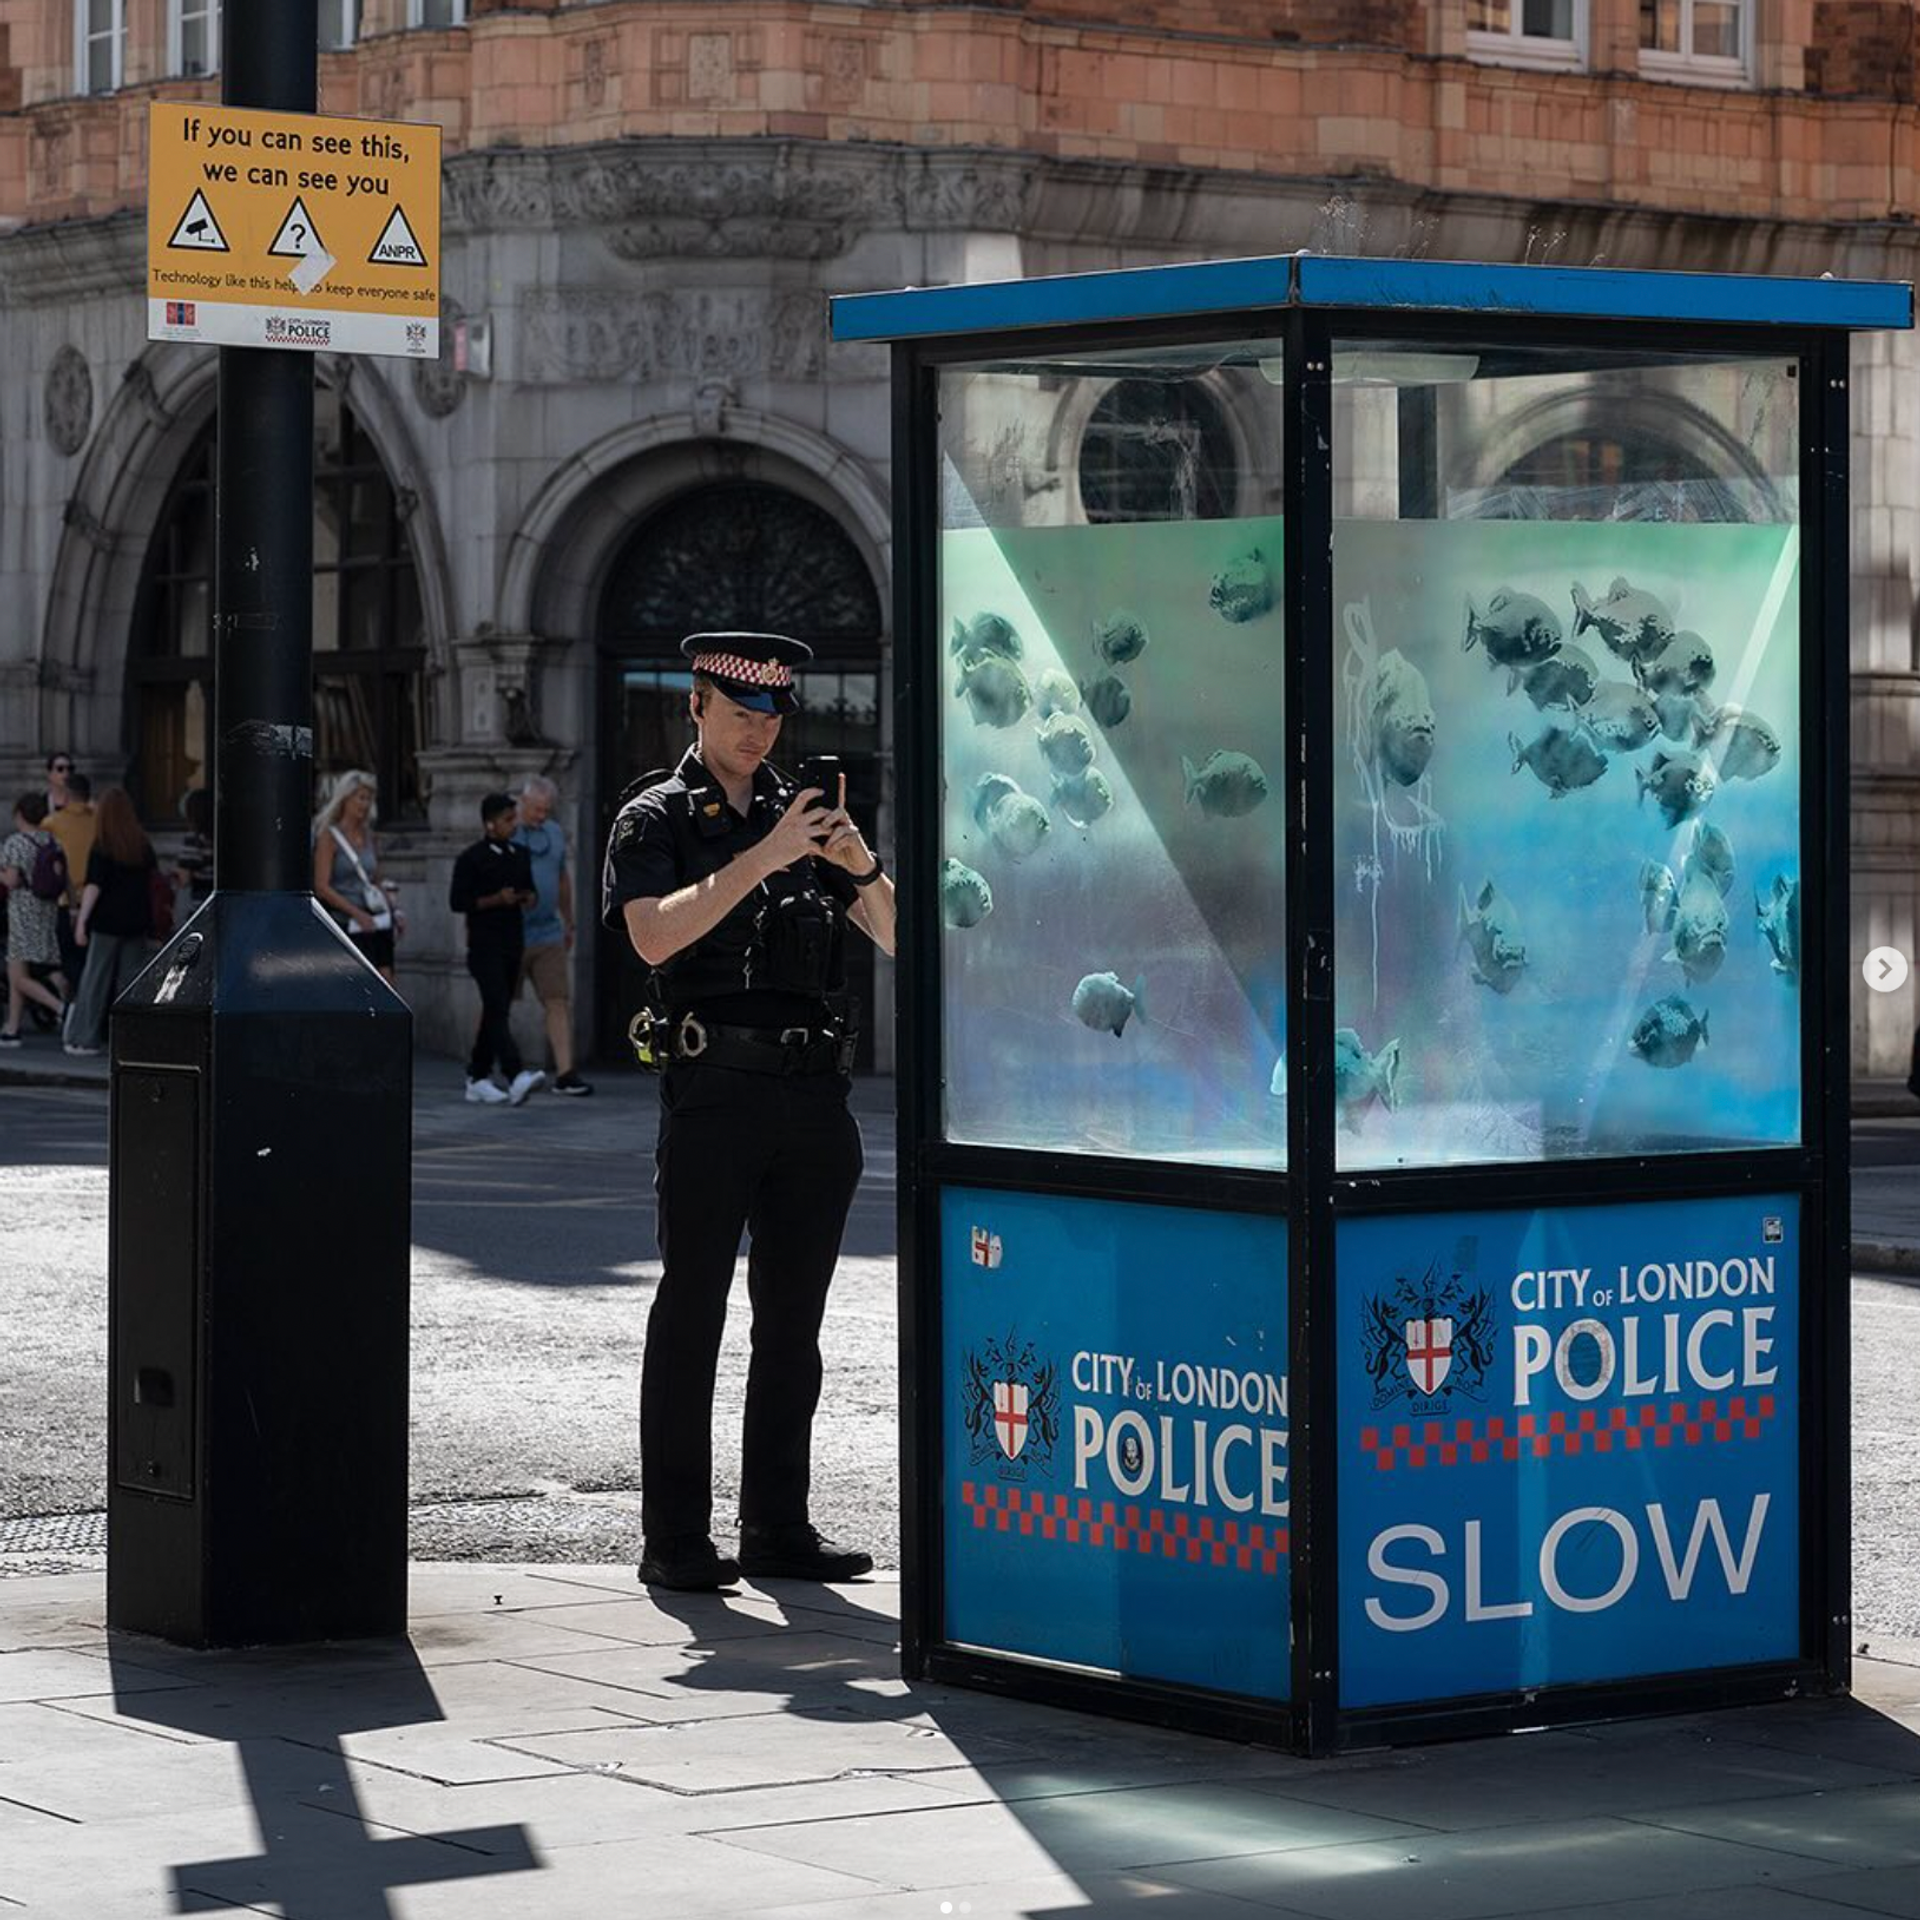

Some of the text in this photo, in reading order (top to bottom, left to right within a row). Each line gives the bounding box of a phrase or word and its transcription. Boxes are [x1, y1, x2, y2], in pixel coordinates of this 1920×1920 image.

[184, 118, 409, 163] If you can see this,
[203, 163, 389, 196] we can see you
[378, 244, 416, 259] ANPR
[153, 269, 221, 288] Technology
[225, 274, 247, 287] like
[250, 275, 271, 290] this
[326, 282, 354, 298] keep
[357, 286, 410, 300] everyone
[413, 288, 436, 301] safe
[288, 325, 330, 339] POLICE
[1511, 1256, 1775, 1311] CITY OF LONDON
[1513, 1305, 1779, 1406] POLICE
[1072, 1351, 1289, 1418] CITY OF LONDON
[1073, 1404, 1290, 1518] POLICE
[1364, 1493, 1771, 1632] SLOW
